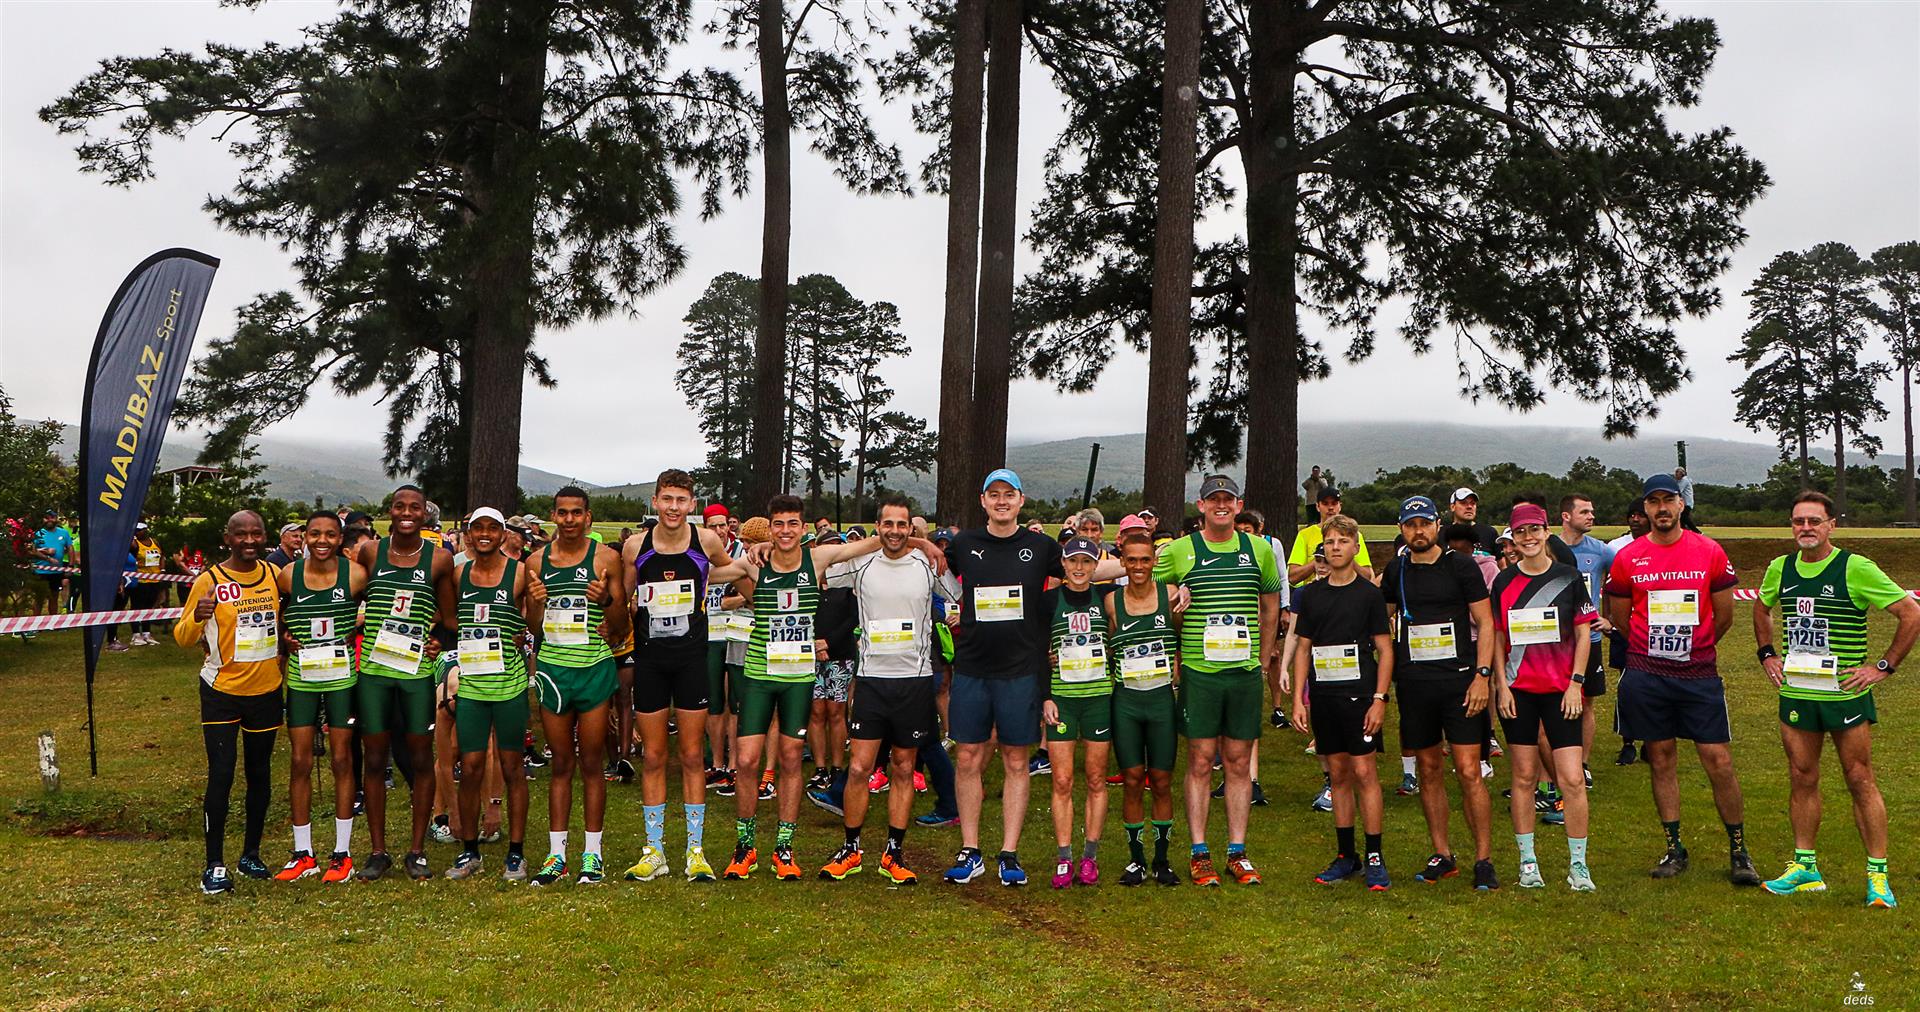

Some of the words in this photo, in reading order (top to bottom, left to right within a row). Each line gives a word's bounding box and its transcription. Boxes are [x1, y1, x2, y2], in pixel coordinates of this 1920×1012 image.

[100, 344, 164, 510] MADIBAZ
[156, 288, 182, 341] Sport
[1631, 573, 1659, 583] TEAM
[1661, 570, 1706, 581] VITALITY
[217, 582, 241, 602] 60
[643, 585, 654, 603] J
[782, 592, 794, 610] J
[232, 596, 274, 607] OUTENIQUA
[237, 603, 273, 614] HARRIERS
[394, 595, 411, 613] J
[1798, 600, 1811, 614] 60
[475, 605, 488, 622] J
[316, 620, 328, 638] J
[1071, 614, 1089, 633] 40
